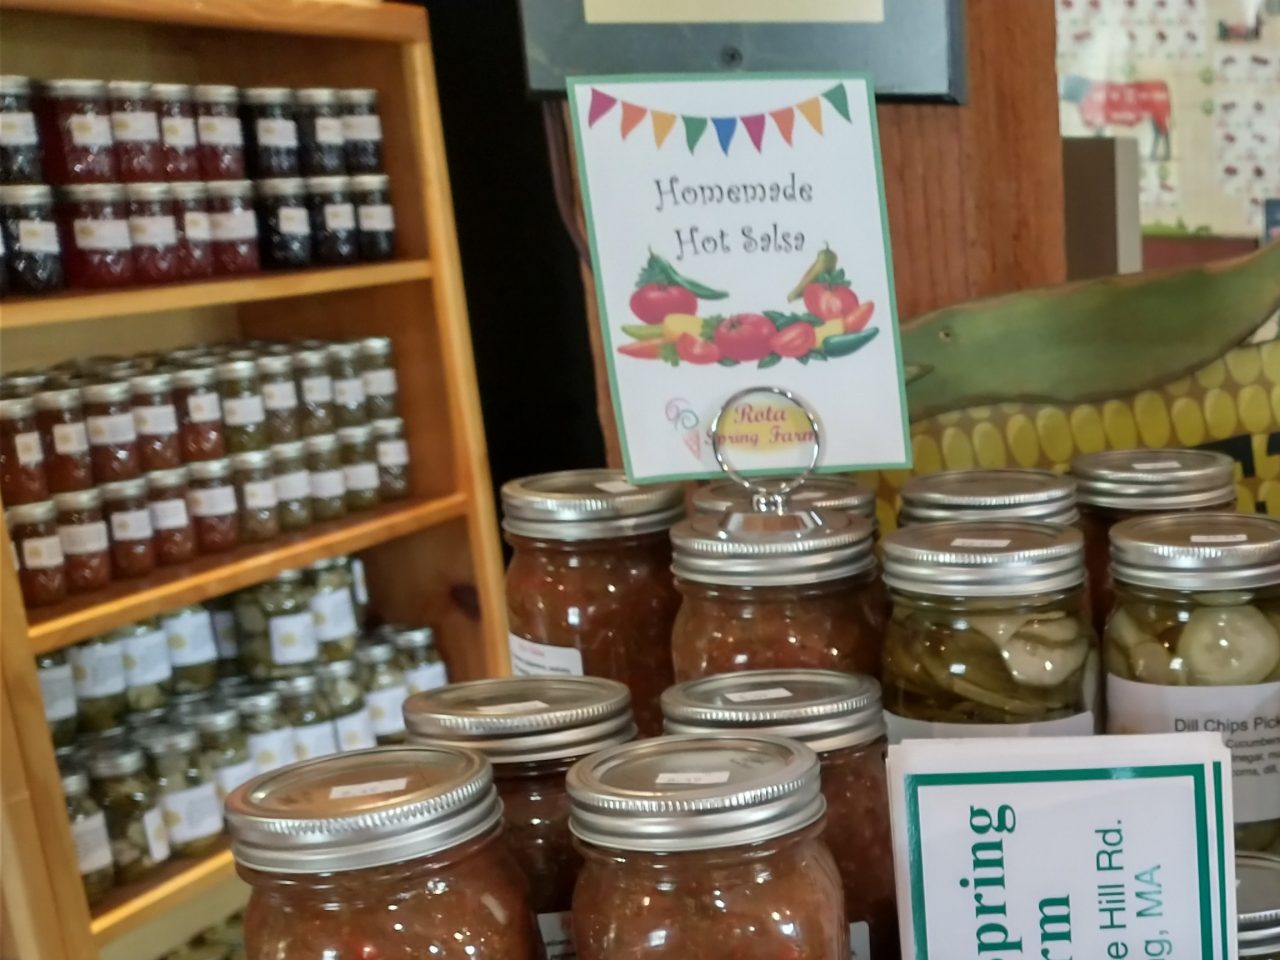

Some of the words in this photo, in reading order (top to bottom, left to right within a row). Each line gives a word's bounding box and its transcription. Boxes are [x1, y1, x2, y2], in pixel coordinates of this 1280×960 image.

[654, 173, 813, 212] Homemade
[675, 225, 731, 261] Hot
[741, 223, 805, 252] Salsa
[735, 403, 786, 423] Rota
[1174, 718, 1198, 732] Dill
[1204, 719, 1248, 734] Chips
[1095, 820, 1123, 871] Rd.
[1098, 884, 1126, 929] Hill
[1134, 864, 1163, 918] MA
